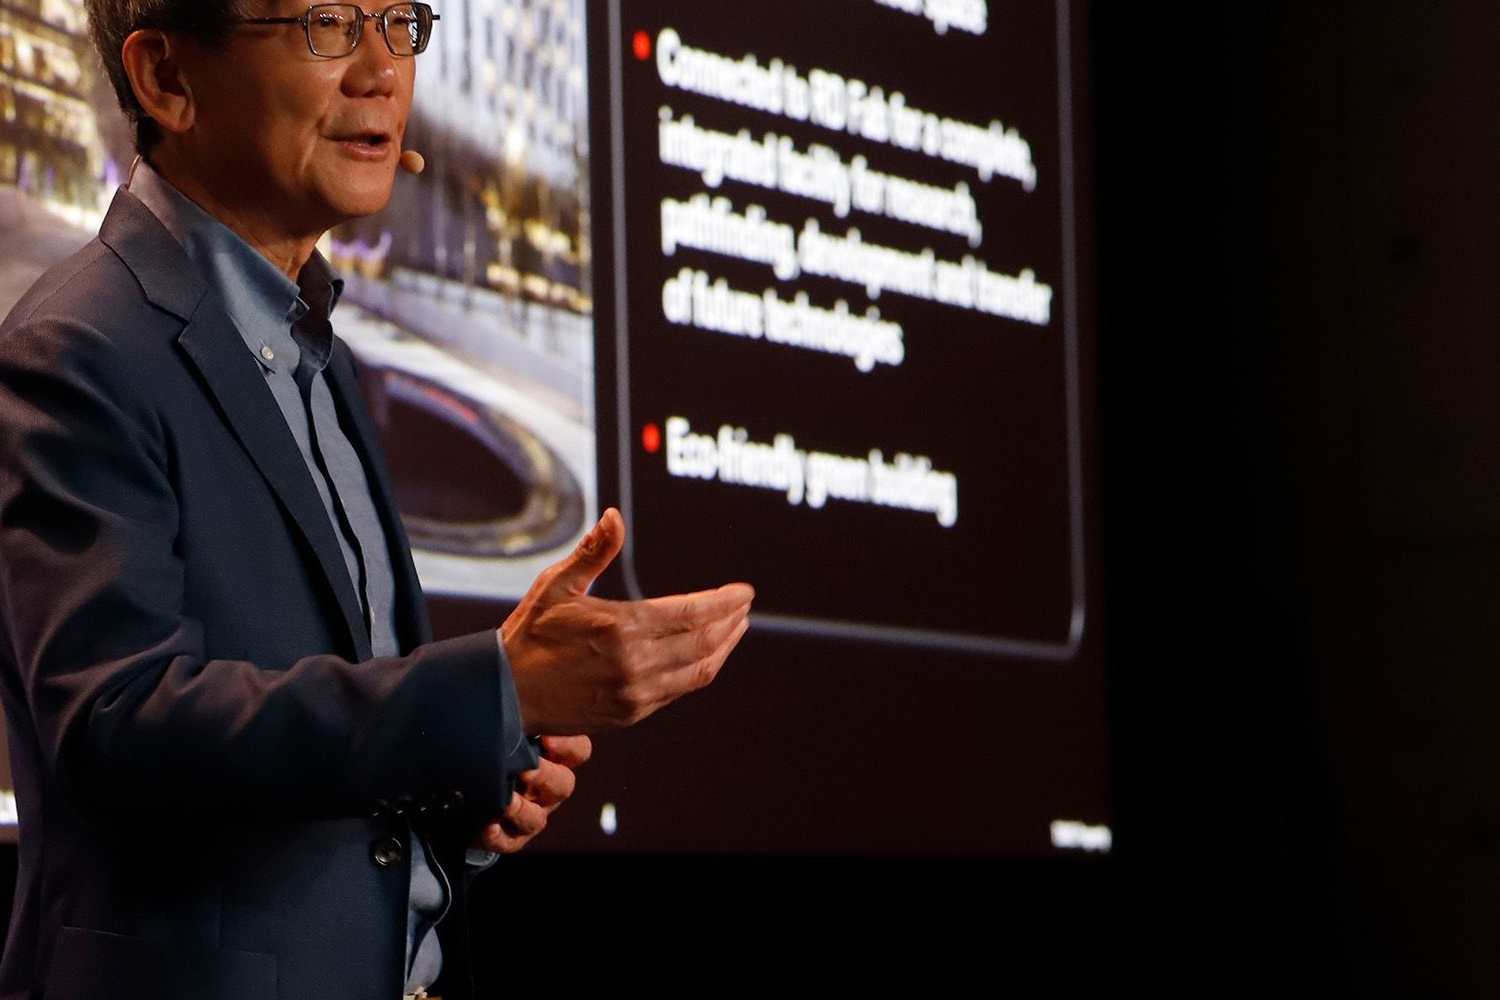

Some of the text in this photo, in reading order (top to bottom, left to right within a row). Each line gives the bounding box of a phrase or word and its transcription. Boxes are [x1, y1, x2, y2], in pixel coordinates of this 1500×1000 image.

[656, 27, 784, 115] Connected
[783, 64, 810, 121] to
[889, 91, 924, 151] for
[850, 153, 886, 214] for
[662, 266, 694, 325] of
[692, 269, 764, 339] future
[665, 416, 805, 506] Eco-friendly
